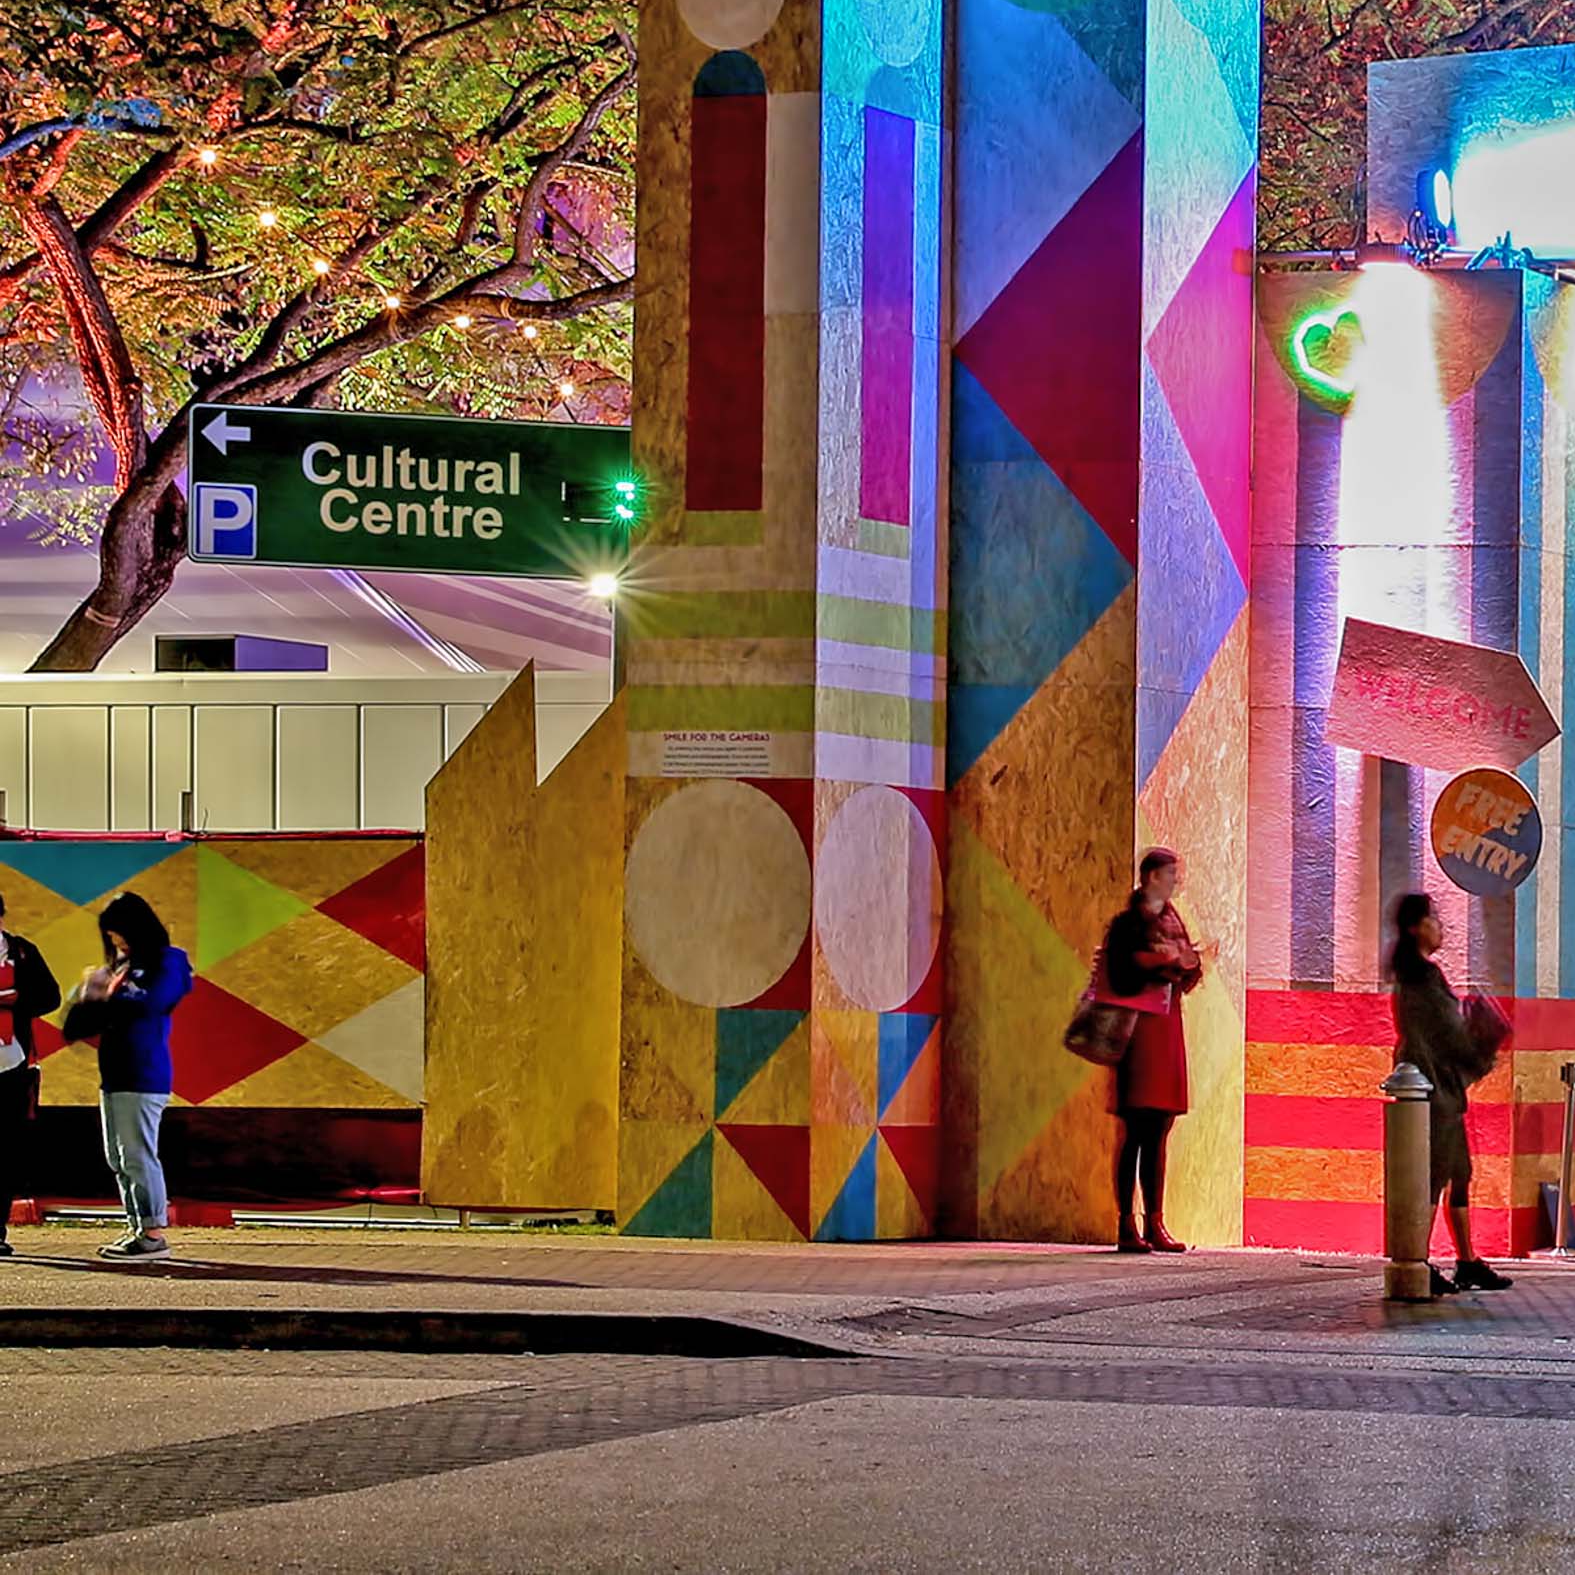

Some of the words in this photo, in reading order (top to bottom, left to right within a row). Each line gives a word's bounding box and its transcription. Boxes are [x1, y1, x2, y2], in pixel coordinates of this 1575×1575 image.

[302, 440, 521, 495] Cultural
[199, 488, 253, 554] P
[319, 488, 503, 540] Centre
[1354, 668, 1533, 740] WELCOME
[664, 732, 687, 741] SMILE
[710, 732, 726, 741] THE
[1455, 782, 1531, 837] FREE
[1440, 826, 1528, 881] ENTRY
